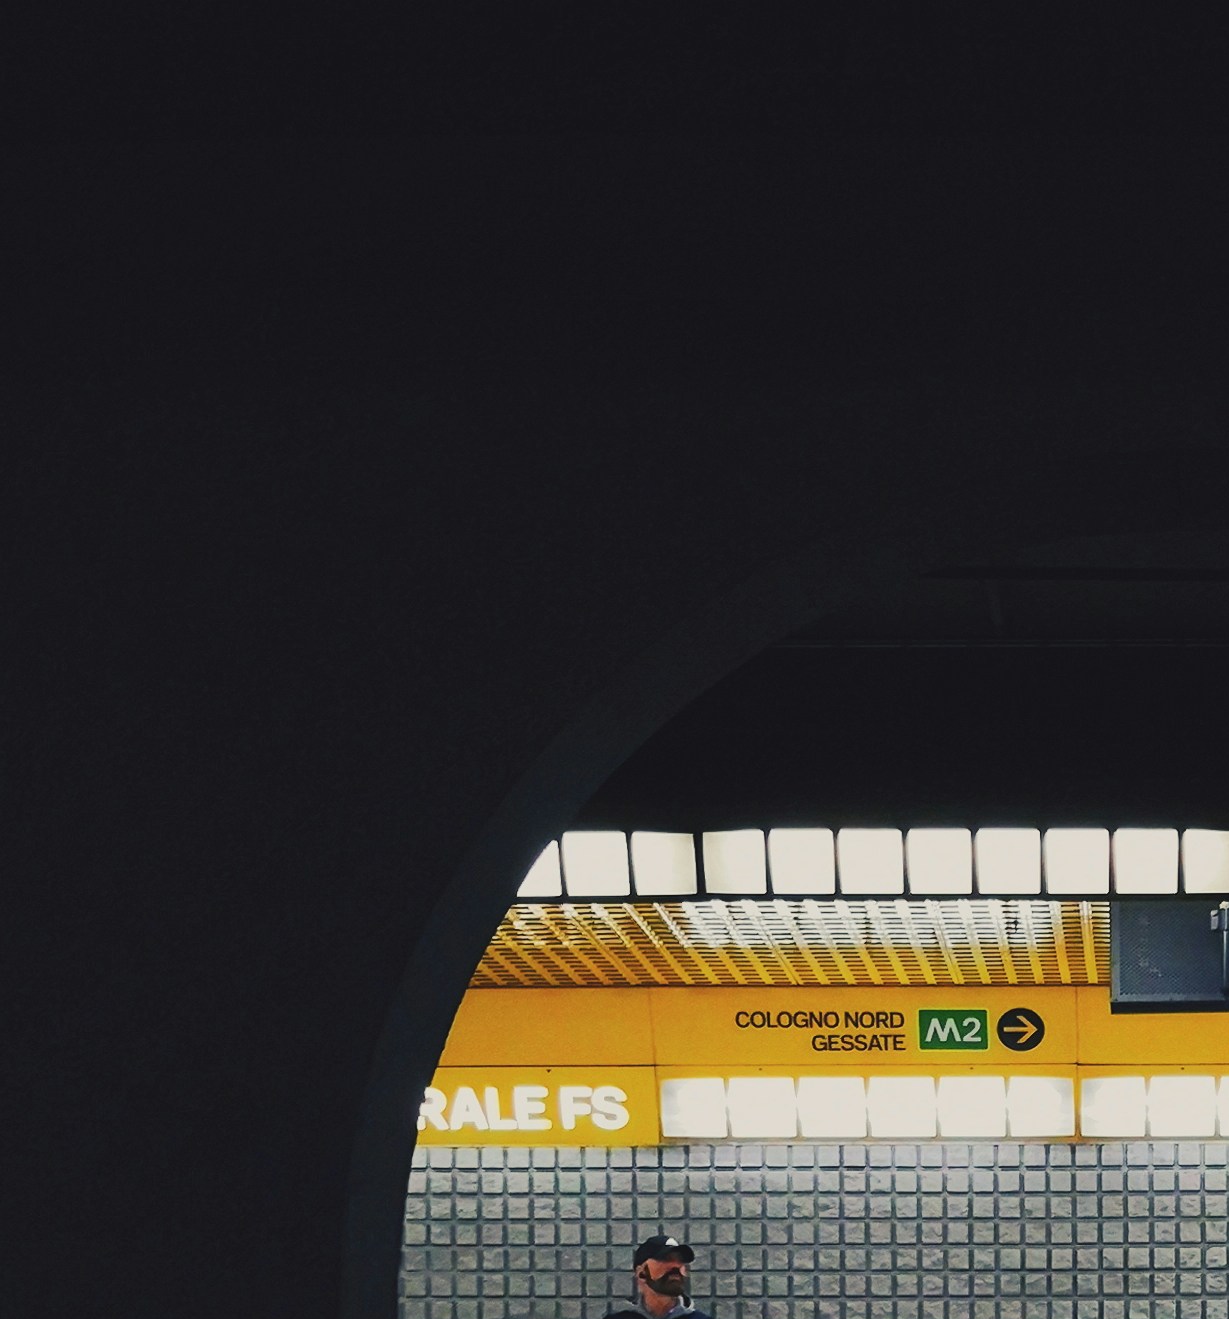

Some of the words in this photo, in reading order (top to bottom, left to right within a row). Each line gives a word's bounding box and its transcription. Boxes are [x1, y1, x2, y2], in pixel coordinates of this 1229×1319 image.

[735, 1011, 840, 1028] COLOGNO
[845, 1011, 904, 1028] NORD
[924, 1016, 982, 1043] M2
[811, 1033, 906, 1052] GESSATE
[416, 1085, 553, 1131] RALE
[559, 1085, 630, 1131] FS
